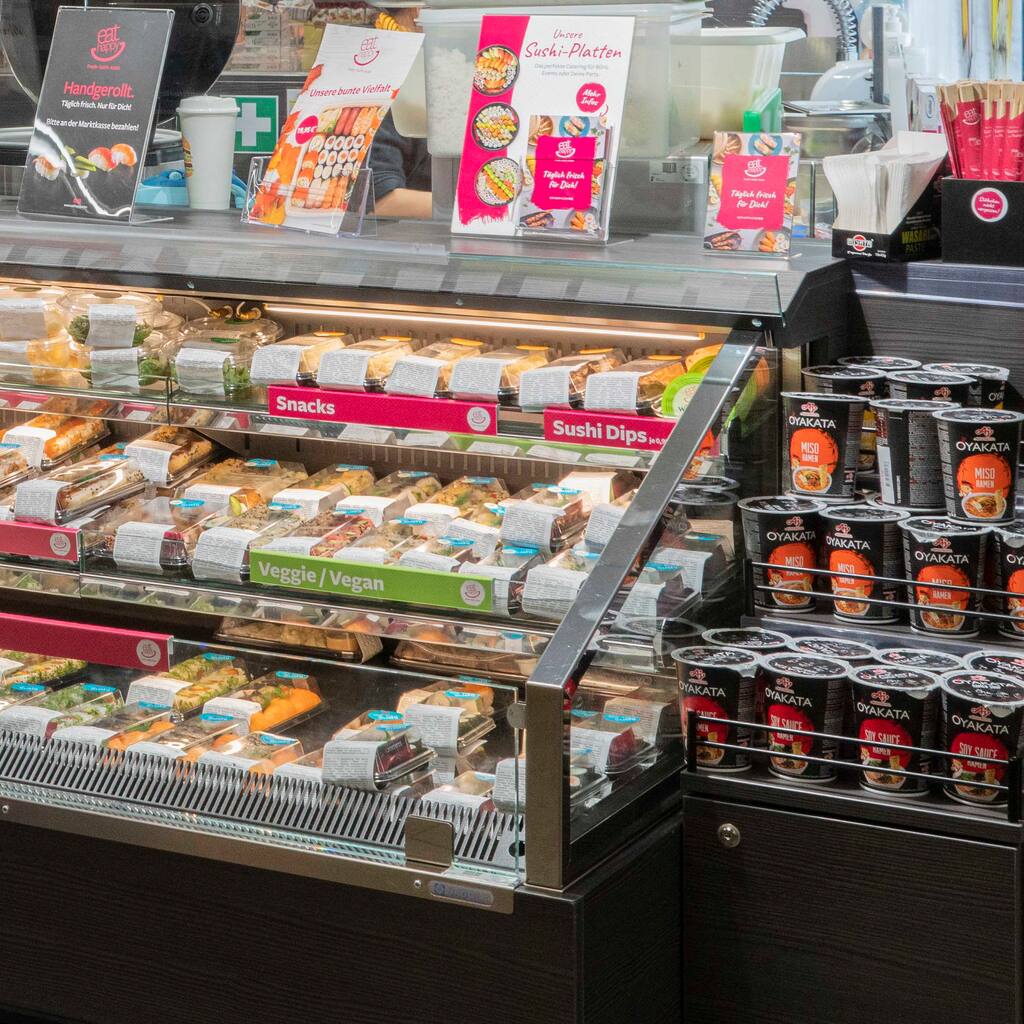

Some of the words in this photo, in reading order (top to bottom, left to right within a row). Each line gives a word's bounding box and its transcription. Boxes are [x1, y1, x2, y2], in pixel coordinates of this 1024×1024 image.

[97, 24, 120, 44] eat
[553, 28, 584, 40] Unsere
[524, 41, 623, 59] Sushi-Platten
[63, 80, 135, 101] Handgerollt.
[309, 89, 337, 97] Unsere
[338, 87, 360, 97] bunte
[362, 83, 391, 95] Vielfalt
[583, 89, 601, 98] Mehr
[61, 99, 80, 110] Täglich
[80, 100, 97, 110] frisch.
[97, 102, 108, 110] Nur
[108, 102, 117, 111] für
[117, 102, 132, 112] Dich!
[46, 118, 61, 127] Bitte
[68, 119, 78, 128] der
[78, 120, 111, 130] Marktkasse
[111, 122, 139, 132] bezahlen!
[543, 170, 566, 180] Täglich
[566, 171, 585, 180] frisch
[549, 180, 560, 189] für
[560, 180, 579, 189] Dich!
[730, 189, 755, 200] Täglich
[756, 190, 777, 199] frisch
[736, 200, 748, 209] für
[749, 200, 769, 209] Dich!
[275, 395, 335, 416] Snacks
[788, 415, 837, 429] OYAKATA
[552, 419, 603, 440] Sushi
[606, 424, 648, 447] Dips
[800, 441, 820, 455] MISO
[956, 441, 1011, 452] OYAKATA
[801, 454, 819, 464] RAMEN
[975, 467, 996, 479] MISO
[976, 479, 995, 489] RAMEN
[766, 530, 817, 542] OYAKATA
[825, 535, 871, 551] OYAKATA
[784, 555, 805, 567] MISO
[914, 550, 969, 564] OYAKATA
[258, 560, 317, 586] Veggie
[319, 567, 327, 588] /
[329, 569, 384, 593] Vegan
[678, 681, 727, 697] OYAKATA
[764, 687, 813, 708] OYAKATA
[856, 701, 910, 720] OYAKATA
[951, 714, 1009, 735] OYAKATA
[864, 728, 877, 742] SOY
[959, 741, 973, 755] SOY
